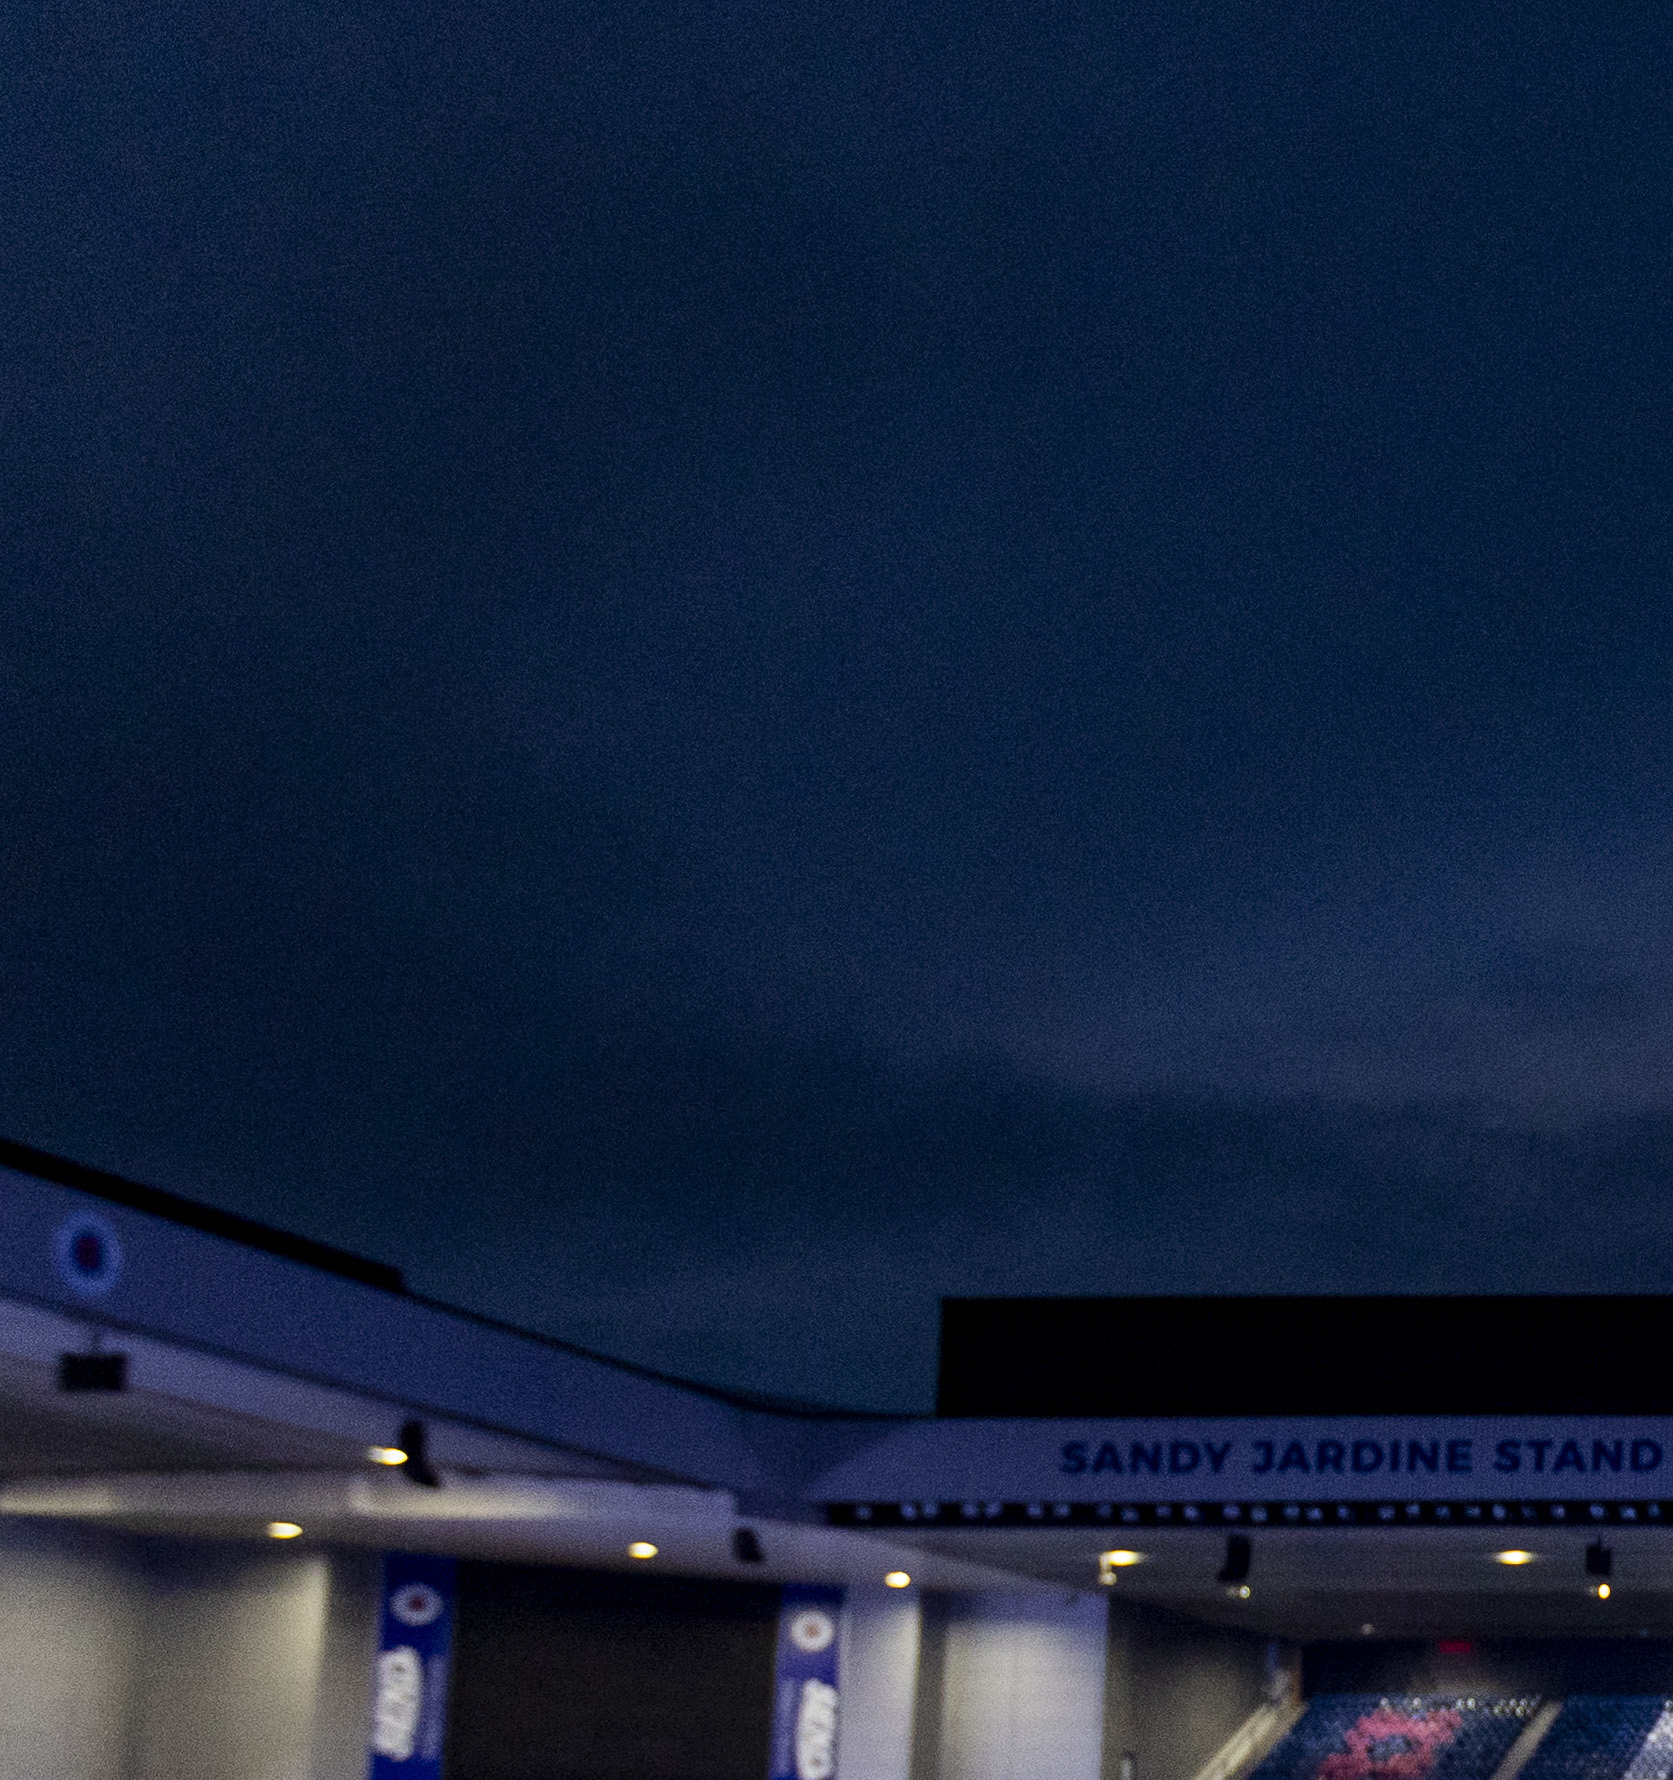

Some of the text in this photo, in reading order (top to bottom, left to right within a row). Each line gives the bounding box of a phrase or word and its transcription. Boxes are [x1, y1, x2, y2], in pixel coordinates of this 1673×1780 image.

[1060, 1438, 1664, 1476] SANDY JARDINE STAND
